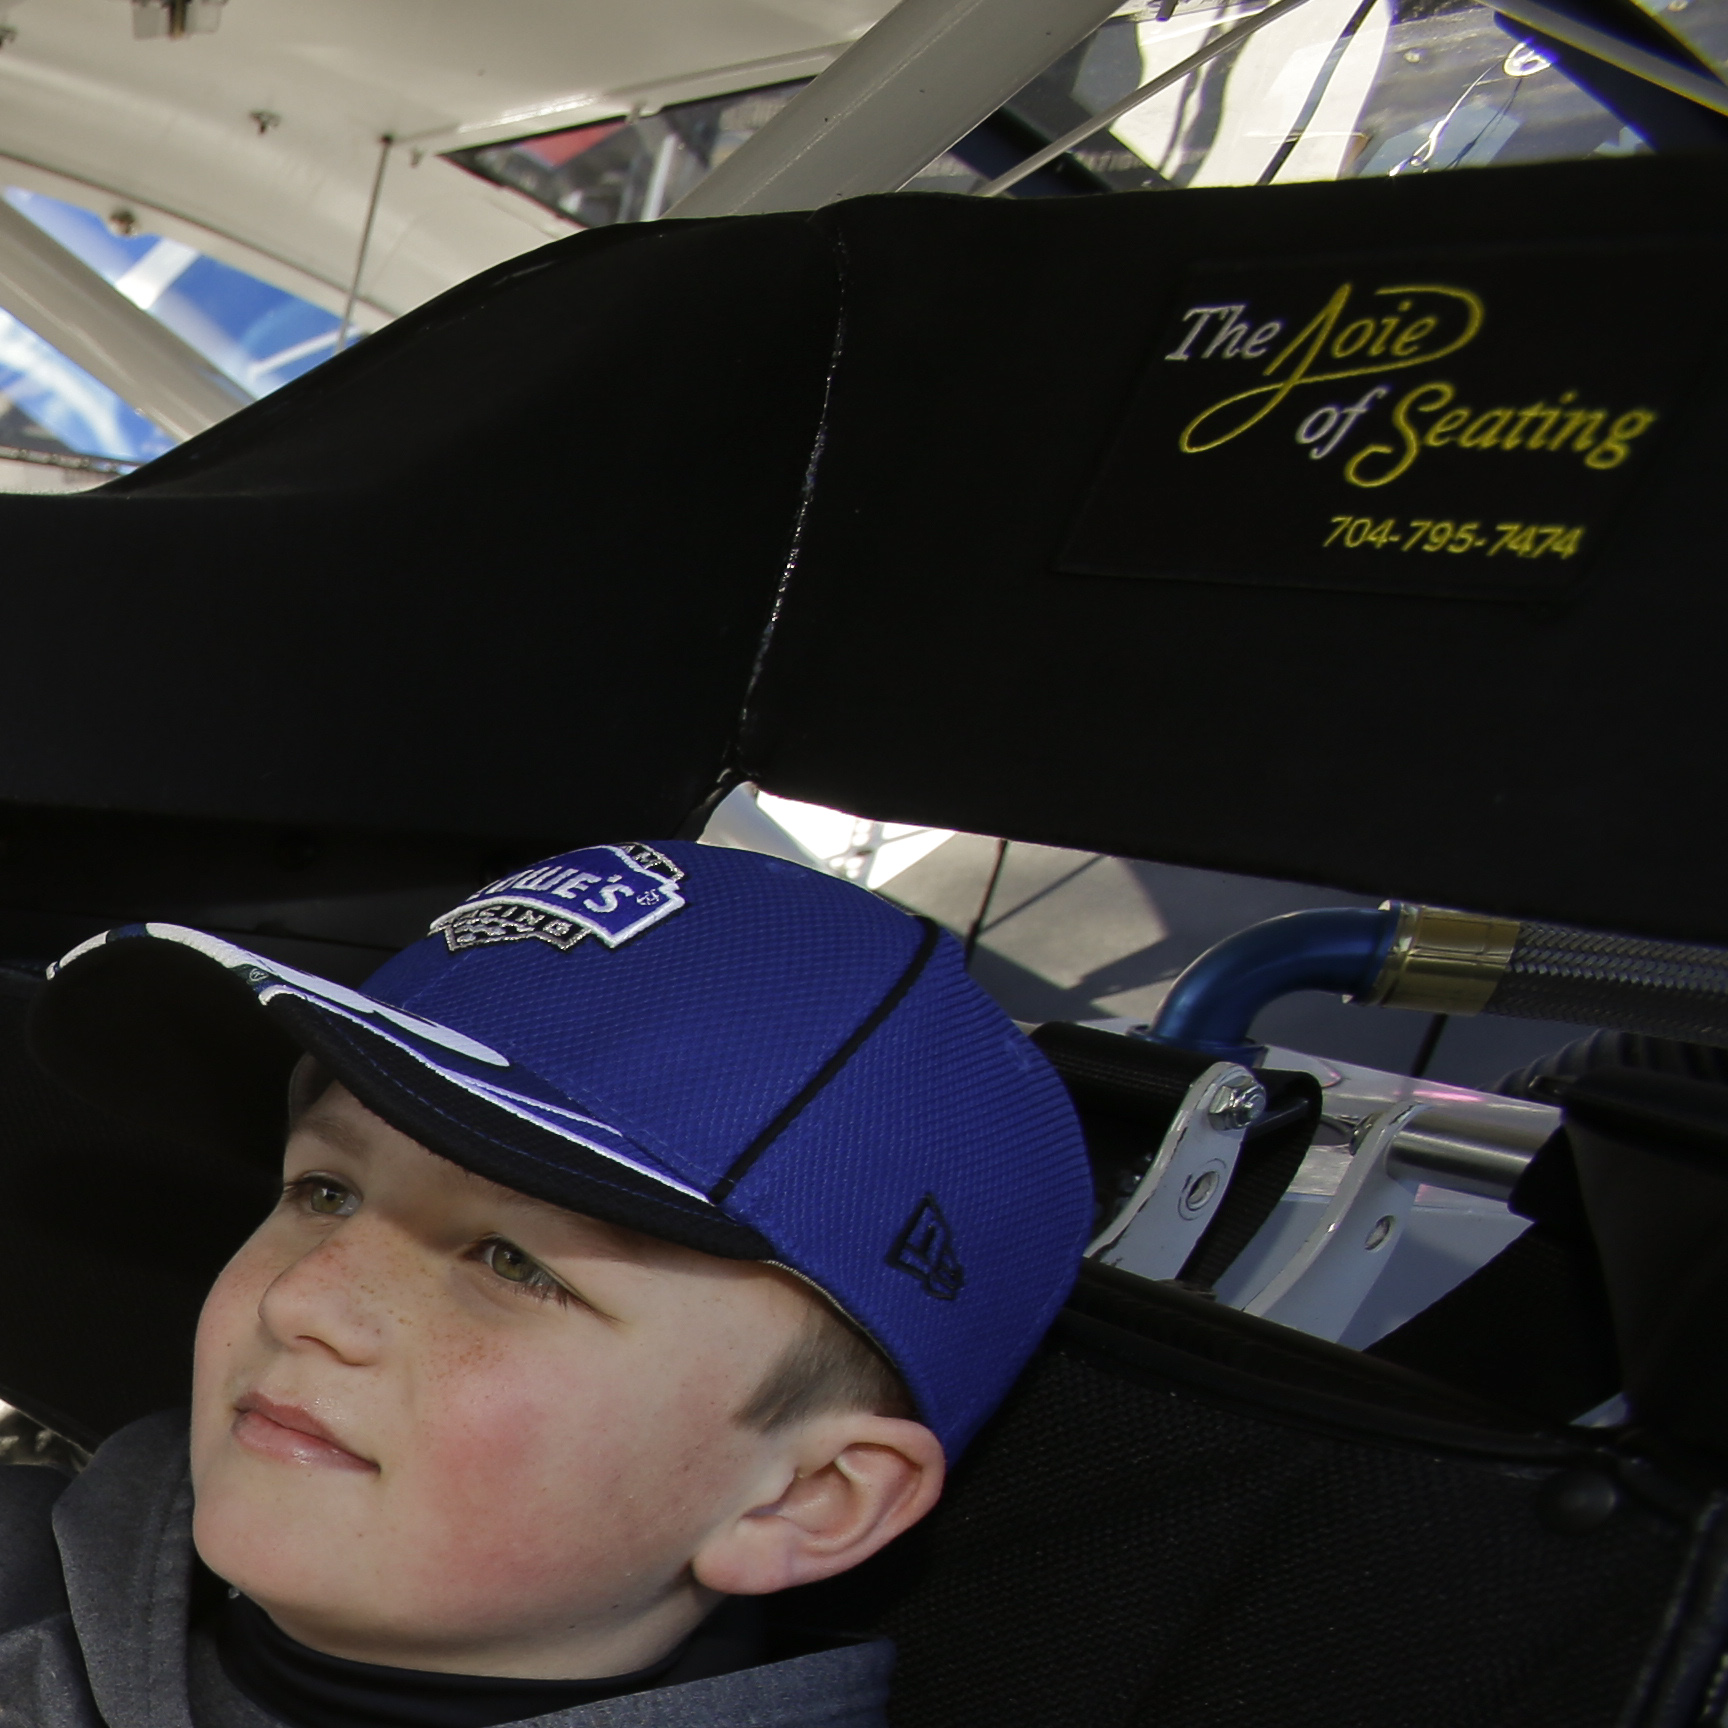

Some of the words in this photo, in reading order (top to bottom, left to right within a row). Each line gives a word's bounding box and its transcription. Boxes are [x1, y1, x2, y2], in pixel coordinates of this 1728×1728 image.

[1164, 304, 1282, 361] The
[1180, 282, 1484, 453] Joie
[1295, 384, 1392, 460] of
[1346, 381, 1657, 488] Seating
[1323, 515, 1585, 559] 704-795-7474
